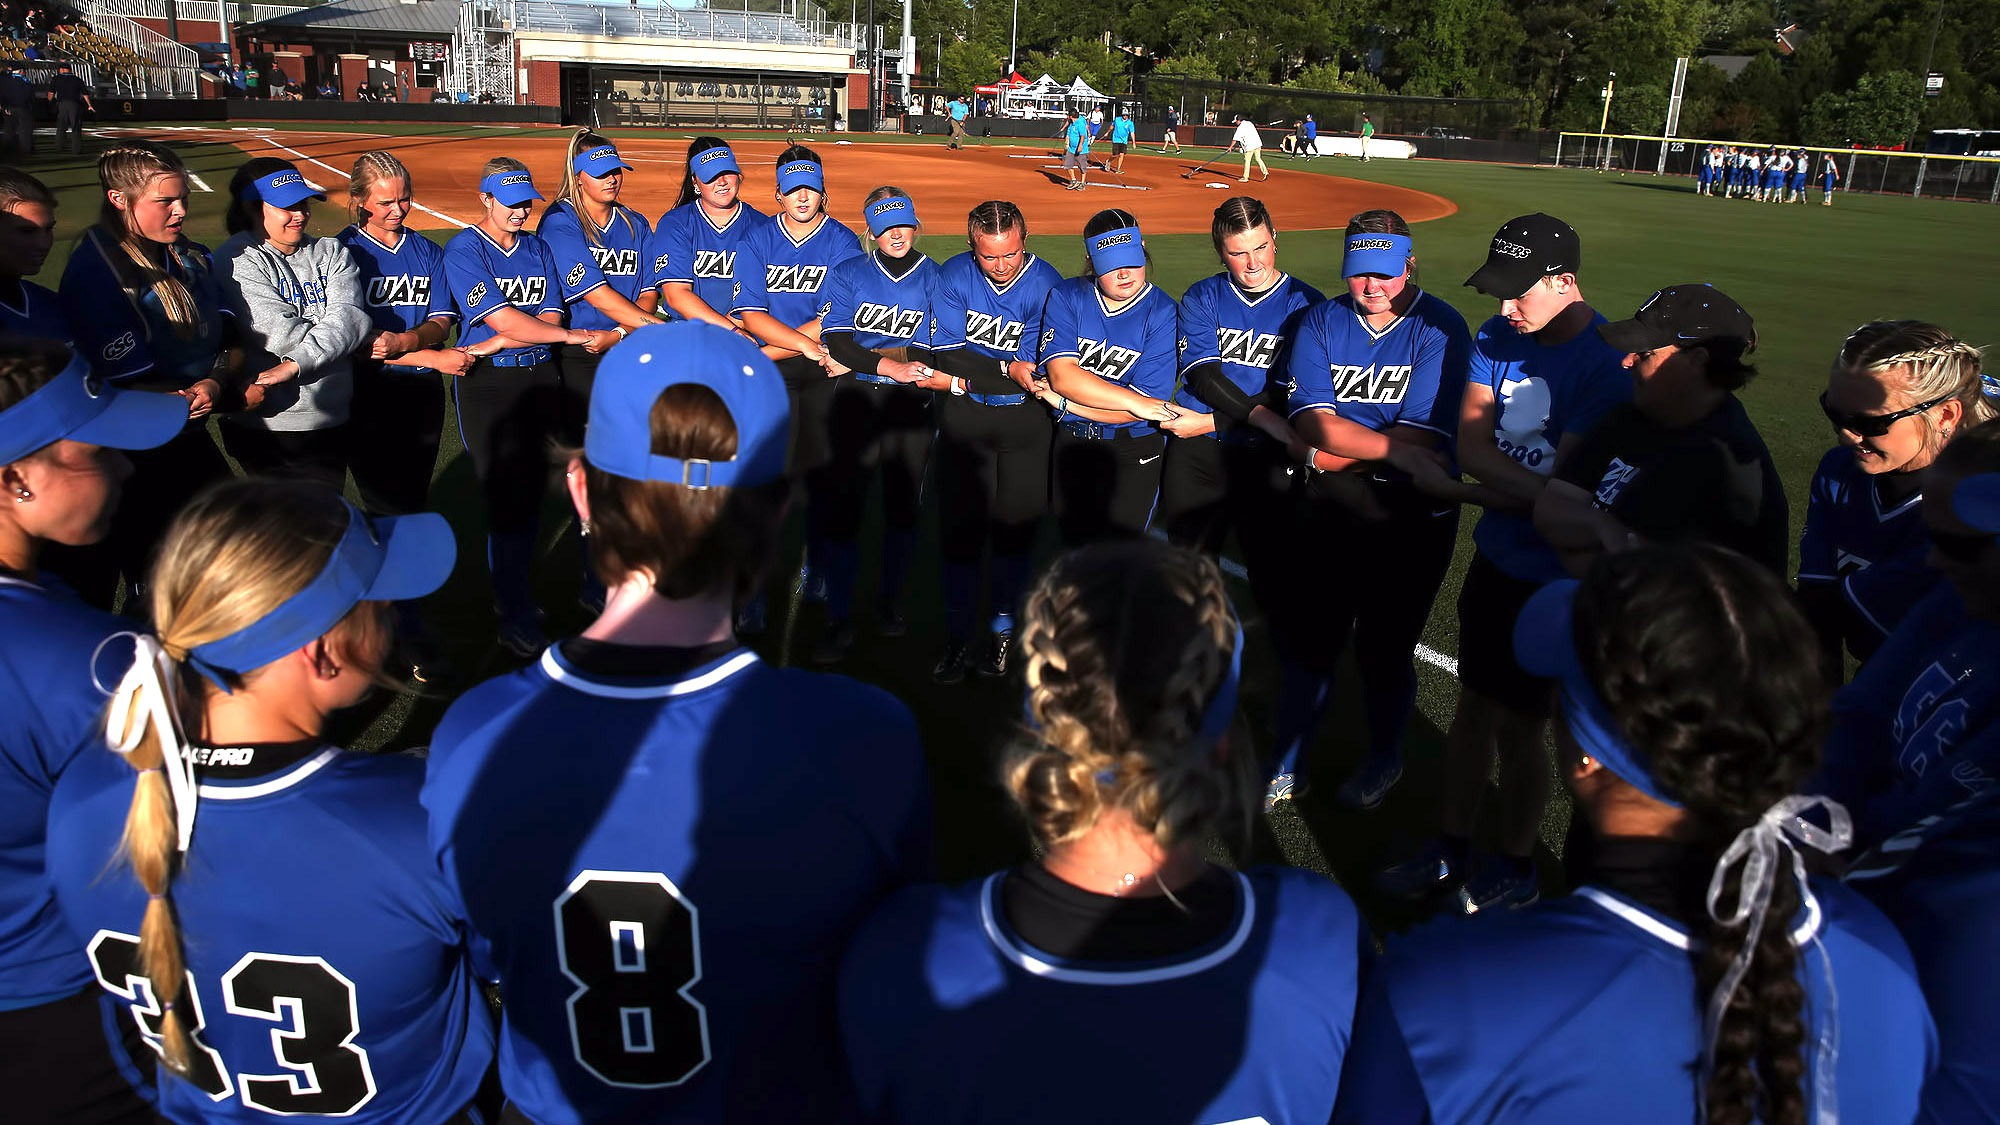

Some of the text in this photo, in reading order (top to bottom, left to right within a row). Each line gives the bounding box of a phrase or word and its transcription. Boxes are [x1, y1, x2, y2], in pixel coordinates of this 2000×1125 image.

[1671, 142, 1685, 152] 225
[1096, 233, 1132, 250] CHARGERS
[1350, 239, 1393, 251] CHARGERS
[367, 272, 430, 306] UAH
[766, 264, 827, 293] UAH
[854, 302, 924, 338] UAH
[966, 310, 1025, 351] UAH
[1217, 328, 1284, 368] UAH
[1330, 363, 1411, 403] UAH
[208, 748, 254, 766] PRO
[554, 870, 711, 1088] 8
[87, 929, 377, 1117] 33
